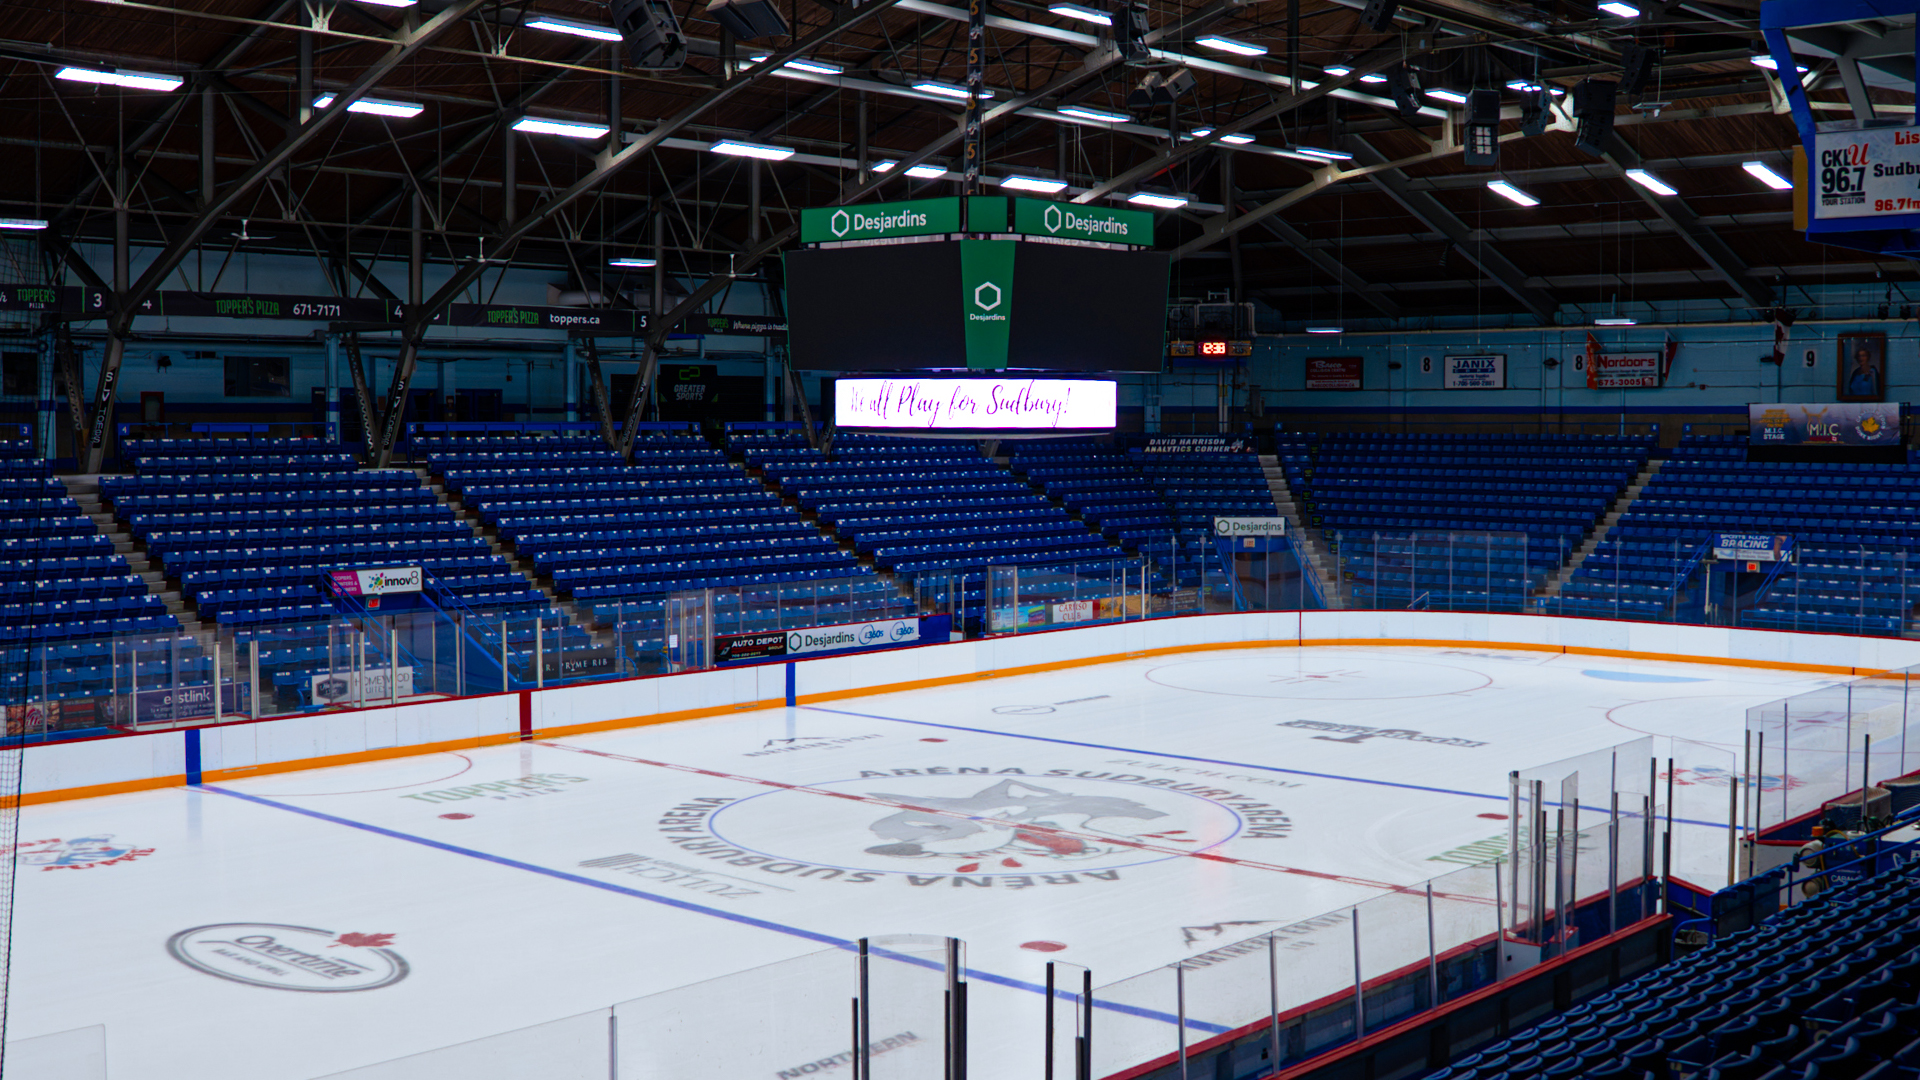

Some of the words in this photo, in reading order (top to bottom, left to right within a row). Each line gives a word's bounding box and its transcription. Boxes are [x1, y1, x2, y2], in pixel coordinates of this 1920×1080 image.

[1822, 166, 1866, 193] 96.7
[1822, 198, 1838, 206] YOUR
[1839, 196, 1866, 205] STATION
[854, 209, 927, 233] Desjardins
[1065, 211, 1128, 235] Desjardins
[17, 287, 56, 303] TOPPER'S
[92, 293, 103, 308] 3
[215, 297, 255, 315] TOPPER'S
[256, 299, 280, 316] PIZZA
[293, 303, 341, 317] 671-7171
[487, 307, 519, 324] TOPPER'S
[520, 310, 540, 325] PIZZA
[549, 313, 601, 326] toppers.ca
[640, 315, 648, 328] 5
[969, 313, 1006, 322] Desjardins
[1423, 357, 1431, 372] 8
[1452, 360, 1495, 369] JANIX
[1575, 355, 1583, 370] 8
[1597, 354, 1656, 369] Nordoors
[1806, 350, 1815, 368] 9
[673, 384, 706, 393] GREATER
[675, 392, 704, 401] SPORTS
[898, 381, 944, 427] Play
[948, 385, 980, 420] for
[986, 379, 1071, 427] Sudbury!
[1809, 424, 1842, 436] M.I.C.
[1144, 445, 1192, 453] ANALYTICS
[1194, 445, 1231, 453] CORNER
[1232, 521, 1282, 533] Desjardins
[1720, 538, 1769, 549] BRACING
[384, 570, 419, 586] innov8
[731, 639, 754, 648] AUTO
[755, 636, 784, 645] DEPOT
[805, 632, 855, 648] Desjardins
[592, 658, 608, 667] RIB
[163, 688, 211, 705] estlink
[398, 773, 591, 804] TOPPER'S
[1043, 769, 1256, 802] SUDBURY
[1228, 802, 1293, 839] ARENA
[658, 797, 737, 833] ARENA
[666, 835, 887, 884] SUDBURY
[610, 863, 763, 899] ZULICH
[235, 935, 362, 978] Overtime
[775, 1030, 919, 1080] NORTERN
